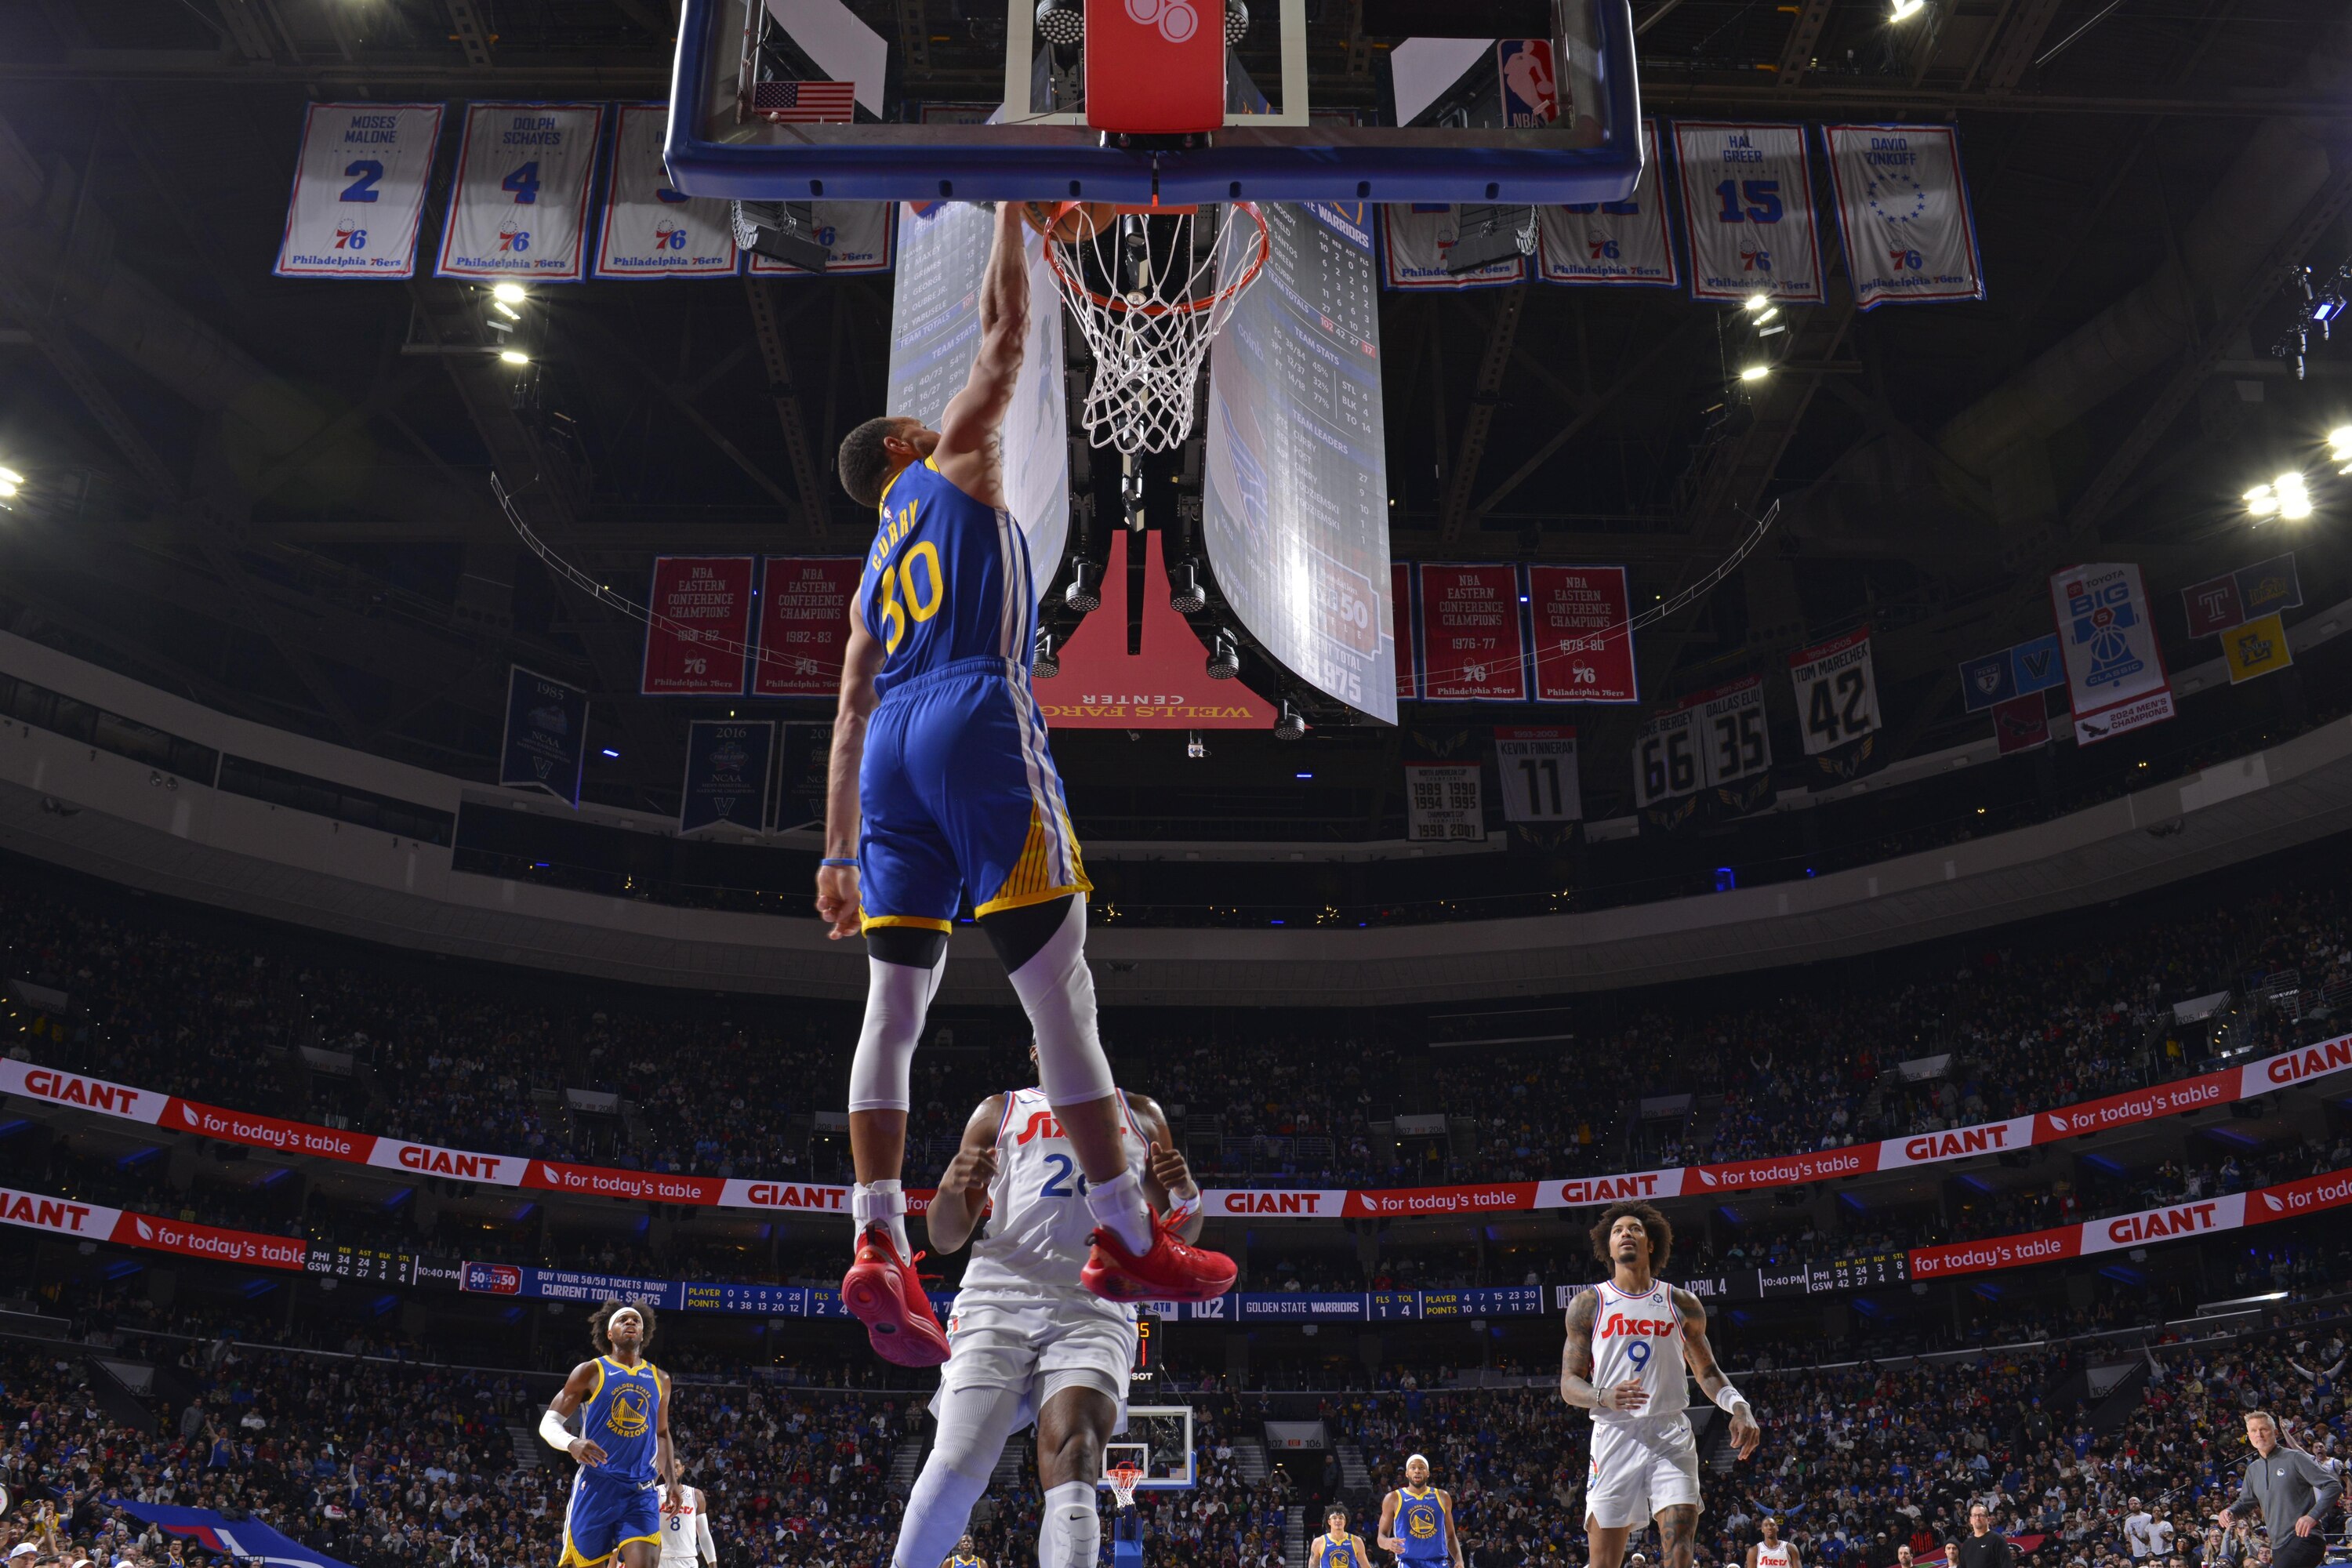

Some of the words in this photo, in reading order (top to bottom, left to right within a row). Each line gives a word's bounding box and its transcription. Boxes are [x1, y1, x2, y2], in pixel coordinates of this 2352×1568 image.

[350, 116, 396, 129] MOSES
[513, 117, 555, 131] DOLPH
[1512, 113, 1539, 129] NBA
[345, 130, 397, 144] MALONE
[503, 132, 561, 146] SCHAYES
[1729, 135, 1752, 148] HAL
[1871, 138, 1907, 151] DAVID
[1723, 151, 1762, 163] GREER
[1866, 152, 1916, 166] ZINKOFF
[339, 160, 384, 203] 2
[502, 162, 541, 204] 4
[1715, 180, 1783, 224] 15
[1318, 205, 1369, 248] WARRIORS
[335, 230, 366, 249] 76
[499, 231, 530, 252] 76
[655, 230, 686, 249] 76
[1274, 232, 1298, 259] SANTOS
[292, 255, 366, 267] Philadelphia
[370, 257, 401, 267] 76ers
[456, 257, 531, 269] Philadelphia
[534, 259, 565, 269] 76ers
[613, 256, 688, 266] Philadelphia
[692, 256, 723, 265] 76ers
[915, 245, 942, 266] MAXEY
[1740, 249, 1771, 271] 76
[1890, 249, 1923, 270] 76
[913, 260, 942, 280] GRIMES
[913, 273, 942, 296] GEORGE
[1268, 268, 1285, 295] TEAM
[1284, 288, 1309, 314] TOTALS
[1705, 277, 1777, 289] Philadelphia
[1780, 280, 1810, 290] 76ers
[1860, 276, 1931, 292] Philadelphia
[1933, 274, 1963, 285] 76ers
[912, 299, 947, 326] YABUSELE
[900, 329, 921, 347] TEAM
[922, 313, 950, 336] TOTALS
[932, 339, 954, 359] TEAM
[955, 321, 978, 343] STATS
[1294, 326, 1316, 350] TEAM
[1316, 343, 1339, 365] STATS
[1285, 338, 1306, 361] 38/84
[1287, 355, 1305, 375] 12/37
[1293, 410, 1313, 433] TEAM
[1313, 426, 1348, 455] LEADERS
[1295, 478, 1340, 515] PODZIEMSKI
[872, 499, 919, 572] CURRY
[691, 567, 713, 579] NBA
[802, 568, 823, 580] NBA
[1459, 575, 1480, 586] NBA
[2085, 568, 2125, 588] TOYOTA
[678, 580, 725, 591] EASTERN
[788, 582, 836, 593] EASTERN
[1566, 577, 1588, 588] NBA
[668, 593, 734, 605] CONFERENCE
[779, 595, 844, 607] CONFERENCE
[1447, 587, 1494, 599] EASTERN
[1555, 590, 1601, 601] EASTERN
[2069, 582, 2129, 616] BIG
[670, 606, 730, 618] CHAMPIONS
[780, 608, 840, 619] CHAMPIONS
[1439, 601, 1504, 612] CONFERENCE
[1547, 603, 1611, 614] CONFERENCE
[1443, 615, 1502, 626] CHAMPIONS
[1551, 615, 1610, 627] CHAMPIONS
[2096, 612, 2110, 622] 5
[786, 631, 832, 643] 1982-83
[1452, 637, 1495, 649] 1976-77
[1560, 639, 1604, 651] 1979-80
[1334, 648, 1362, 672] TOTAL
[1795, 667, 1816, 684] TOM
[1818, 644, 1867, 676] MARECHEK
[2089, 662, 2140, 686] CLASSIC
[535, 682, 564, 701] 1985
[1083, 695, 1185, 705] CENTER
[1042, 705, 1126, 718] FARG
[1135, 706, 1253, 718] WELLS
[1706, 695, 1740, 718] DALLAS
[1810, 666, 1870, 742] 42
[2110, 709, 2135, 721] 2024
[2136, 698, 2167, 715] MEN'S
[1660, 710, 1693, 731] BERGEY
[2111, 706, 2169, 731] CHAMPIONS
[716, 728, 746, 739] 2016
[1501, 742, 1528, 755] KEVIN
[1530, 742, 1573, 754] FINNERAN
[1716, 708, 1763, 779] 35
[1642, 731, 1693, 800] 66
[1413, 783, 1442, 795] 1989
[1448, 782, 1476, 795] 1990
[1518, 759, 1563, 815] 11
[1414, 797, 1443, 809] 1994
[1449, 797, 1476, 809] 1995
[24, 1069, 138, 1115] GIANT
[204, 1113, 229, 1133] for
[232, 1121, 299, 1149] today's
[304, 1133, 351, 1155] table
[1905, 1124, 2008, 1161] GIANT
[399, 1146, 500, 1180] GIANT
[1721, 1170, 1745, 1185] for
[1748, 1163, 1814, 1183] today's
[1817, 1155, 1860, 1174] table
[1040, 1153, 1088, 1198] 2
[747, 1184, 845, 1210] GIANT
[1562, 1174, 1658, 1203] GIANT
[1225, 1193, 1320, 1214] GIANT
[1381, 1196, 1406, 1210] for
[1409, 1193, 1469, 1211] today's
[1473, 1191, 1516, 1207] table
[2108, 1203, 2216, 1244] GIANT
[313, 1251, 330, 1261] PHI
[1915, 1255, 1940, 1272] for
[1944, 1246, 2012, 1272] today's
[2015, 1240, 2062, 1260] table
[307, 1261, 332, 1273] GSW
[417, 1267, 444, 1278] 10:40
[445, 1271, 460, 1280] PM
[538, 1271, 554, 1281] BUY
[557, 1272, 579, 1284] YOUR
[581, 1275, 606, 1287] 50/50
[609, 1278, 641, 1290] TICKETS
[644, 1282, 667, 1292] NOW!
[1762, 1276, 1788, 1287] 10:40
[1791, 1275, 1806, 1285] PM
[1813, 1271, 1830, 1282] PHI
[542, 1283, 586, 1299] CURRENT
[591, 1288, 623, 1303] TOTAL:
[688, 1287, 721, 1298] PLAYER
[1685, 1279, 1716, 1298] APRIL
[1719, 1278, 1727, 1294] 4
[1811, 1281, 1833, 1292] GSW
[688, 1299, 720, 1308] POINTS
[1153, 1303, 1171, 1312] 4TH
[1191, 1297, 1224, 1319] 102
[1247, 1302, 1279, 1313] GOLDEN
[1281, 1301, 1307, 1313] STATE
[1311, 1301, 1359, 1313] WARRIORS
[1425, 1294, 1457, 1304] PLAYER
[1426, 1305, 1457, 1315] POINTS
[1601, 1312, 1674, 1339] Sixers
[1628, 1340, 1651, 1372] 9
[611, 1383, 634, 1396] GOLDEN
[636, 1385, 652, 1399] STATE
[637, 1399, 644, 1410] 7
[606, 1419, 649, 1438] WARRIORS
[1305, 1439, 1321, 1448] 106
[1409, 1528, 1438, 1539] WARRIORS
